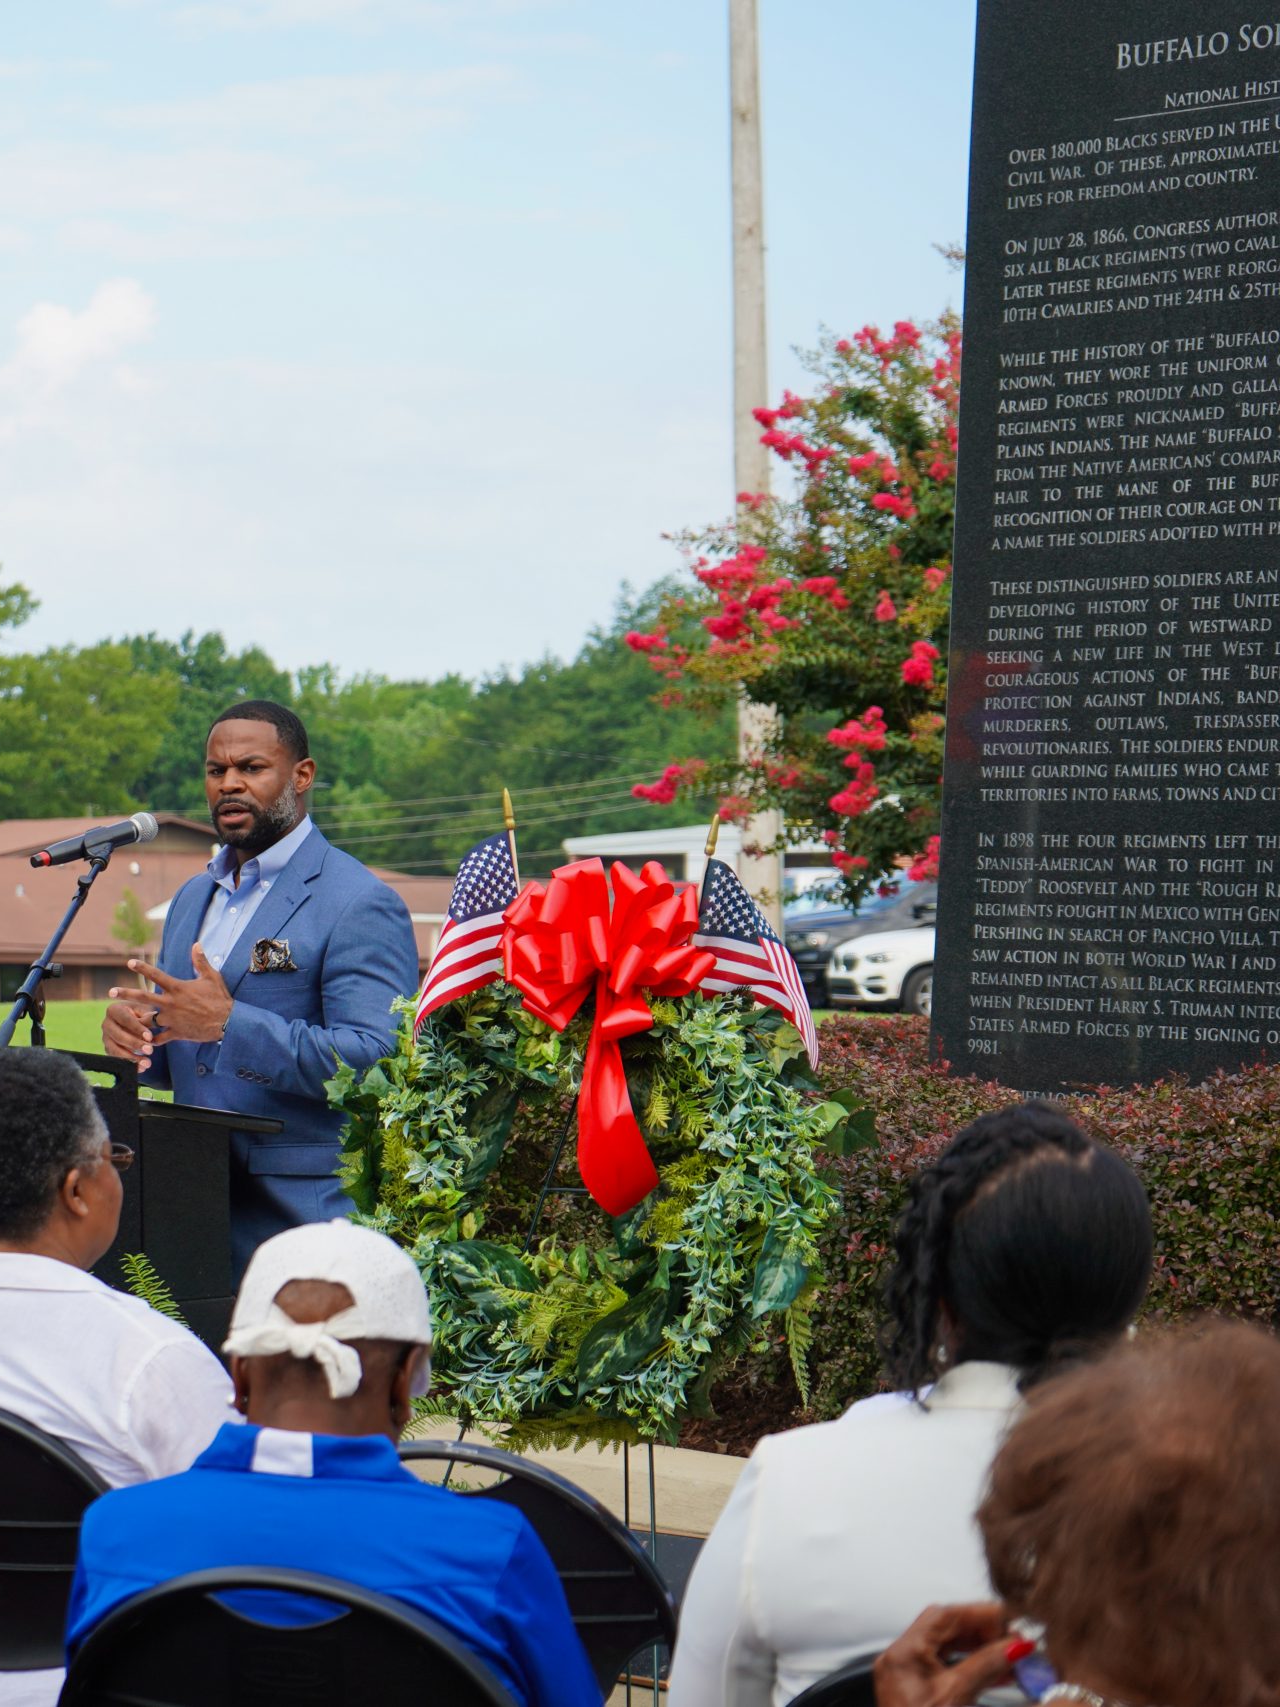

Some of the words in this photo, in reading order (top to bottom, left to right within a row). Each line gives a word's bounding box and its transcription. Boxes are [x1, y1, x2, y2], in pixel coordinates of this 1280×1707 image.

[1051, 138, 1102, 158] 180,000
[1161, 125, 1215, 144] SERVED
[1240, 117, 1270, 133] THE
[1094, 160, 1115, 175] OF
[1007, 193, 1043, 209] LIVES
[1078, 181, 1145, 200] FREEDOM
[1147, 176, 1181, 192] AND
[1003, 263, 1025, 277] SIX
[1027, 260, 1050, 274] ALL
[1104, 245, 1187, 266] REGIMENTS
[1189, 240, 1231, 258] (TWO
[1096, 269, 1178, 290] REGIMENTS
[1182, 265, 1222, 280] WERE
[1003, 307, 1037, 323] 10TH
[1185, 288, 1224, 304] 24TH
[1227, 284, 1241, 300] &
[1083, 342, 1146, 360] HISTORY
[1064, 369, 1102, 384] THEY
[1108, 365, 1151, 380] WORE
[1159, 361, 1189, 376] THE
[1196, 355, 1268, 373] UNIFORM
[1116, 385, 1184, 403] PROUDLY
[997, 417, 1077, 436] REGIMENTS
[1085, 413, 1125, 428] WERE
[1134, 406, 1225, 424] NICKNAMED
[1154, 431, 1197, 447] NAME
[995, 467, 1035, 481] FROM
[993, 490, 1029, 504] HAIR
[1042, 487, 1062, 501] TO
[1116, 481, 1159, 496] MANE
[993, 509, 1093, 527] RECOGNITION
[1118, 504, 1163, 519] THEIR
[1165, 500, 1236, 516] COURAGE
[1004, 535, 1044, 549] NAME
[1079, 528, 1147, 545] SOLDIERS
[1148, 525, 1219, 541] ADOPTED
[1222, 522, 1264, 536] WITH
[1036, 575, 1150, 593] DISTINGUISHED
[1153, 571, 1222, 587] SOLDIERS
[988, 602, 1076, 618] DEVELOPING
[1087, 599, 1150, 614] HISTORY
[987, 626, 1044, 641] DURING
[1094, 622, 1148, 637] PERIOD
[1188, 617, 1273, 633] WESTWARD
[986, 649, 1044, 664] SEEKING
[1072, 647, 1106, 661] NEW
[1115, 646, 1144, 659] LIFE
[984, 671, 1080, 686] COURAGEOUS
[1091, 669, 1155, 683] ACTIONS
[1083, 692, 1146, 707] AGAINST
[1153, 739, 1223, 753] SOLDIERS
[1030, 764, 1108, 778] GUARDING
[1114, 763, 1178, 776] FAMILIES
[1183, 762, 1222, 776] WHO
[1226, 762, 1270, 776] CAME
[979, 788, 1068, 801] TERRITORIES
[1071, 787, 1109, 800] INTO
[1165, 787, 1220, 800] TOWNS
[1003, 832, 1035, 847] 1898
[1077, 834, 1116, 847] FOUR
[1123, 834, 1207, 848] REGIMENTS
[1214, 834, 1249, 848] LEFT
[1199, 858, 1245, 872] FIGHT
[974, 903, 1053, 917] REGIMENTS
[1056, 904, 1117, 918] FOUGHT
[1069, 928, 1123, 941] SEARCH
[971, 948, 1000, 961] SAW
[1003, 949, 1058, 963] ACTION
[1085, 951, 1125, 965] BOTH
[970, 971, 1044, 986] REMAINED
[1046, 974, 1097, 988] INTACT
[1117, 976, 1146, 991] ALL
[1198, 979, 1280, 995] REGIMENTS
[969, 995, 1012, 1008] WHEN
[1194, 1027, 1261, 1043] SIGNING
